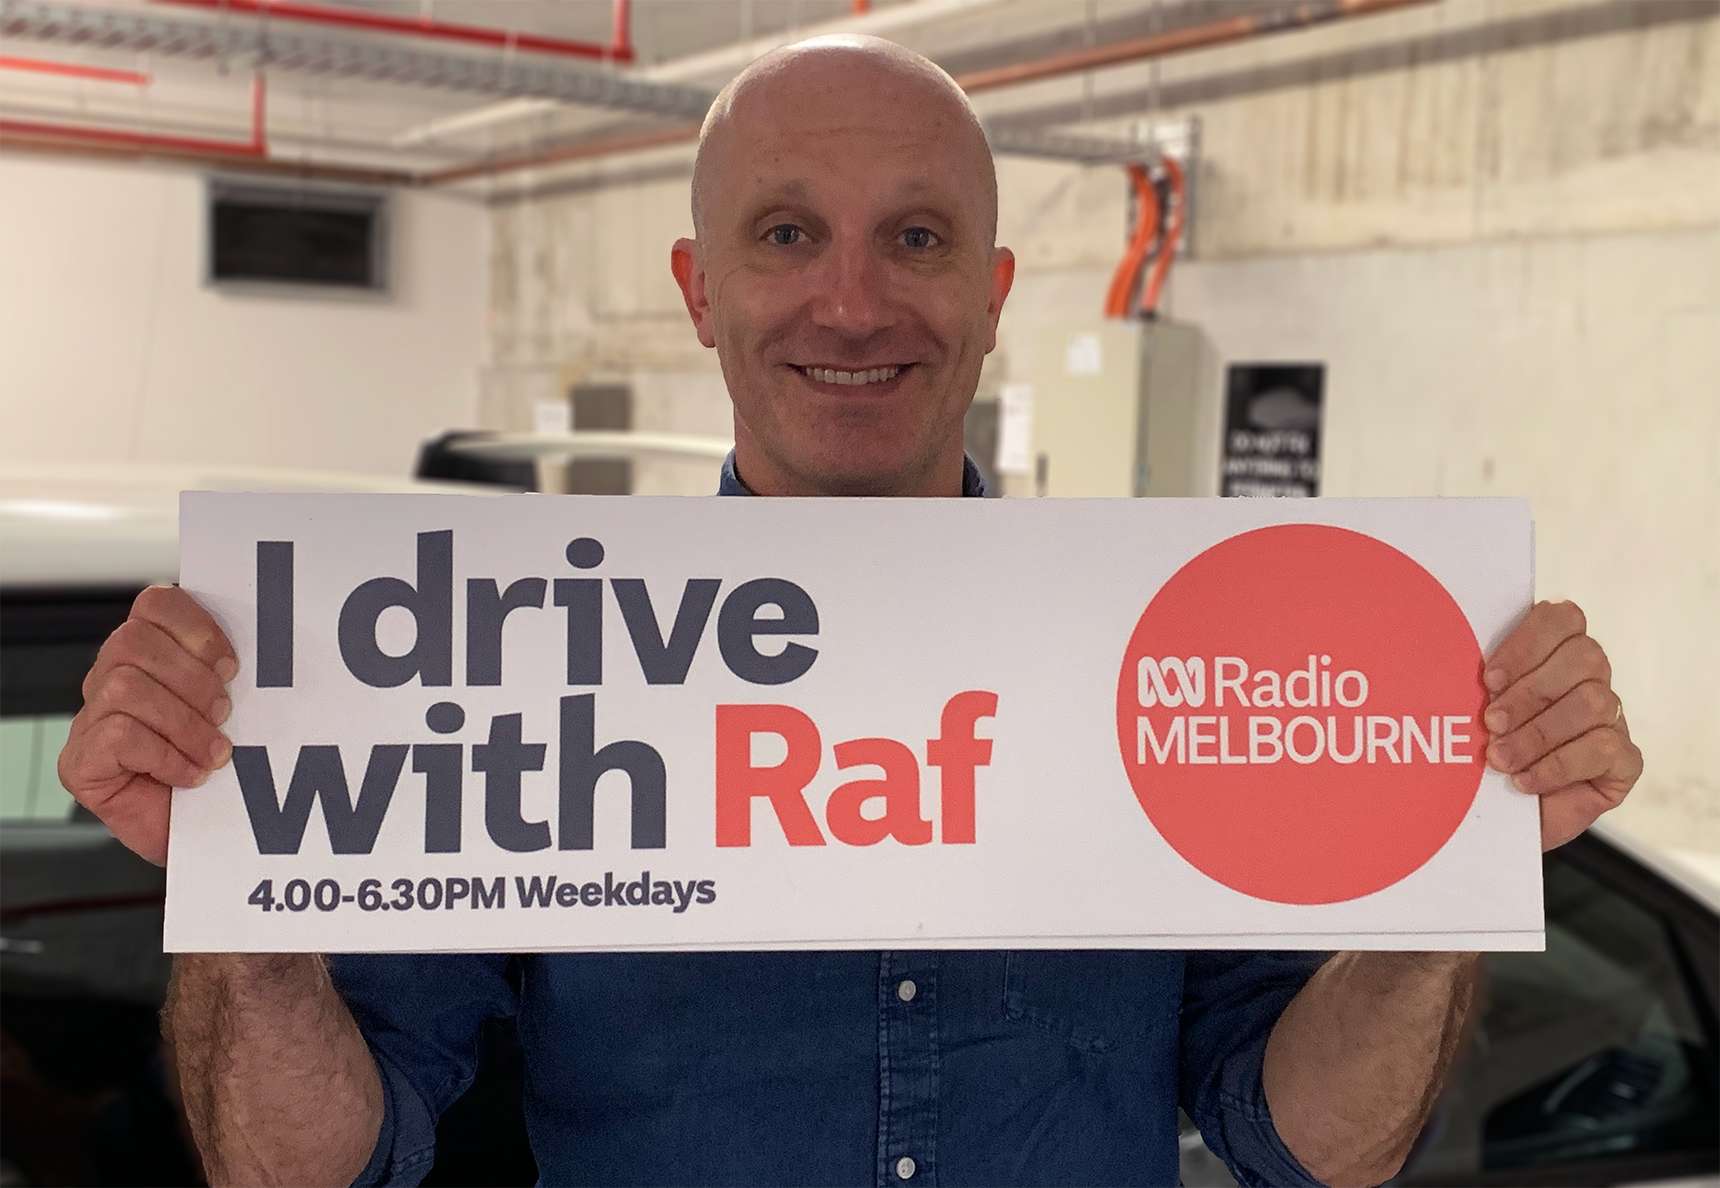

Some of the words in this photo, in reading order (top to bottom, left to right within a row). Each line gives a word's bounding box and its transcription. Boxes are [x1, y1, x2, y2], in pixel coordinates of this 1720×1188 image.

[256, 541, 294, 688] I
[337, 530, 820, 688] drive
[1214, 655, 1369, 708] Radio
[1137, 715, 1473, 765] MELBOURNE
[231, 693, 667, 854] with
[715, 690, 999, 847] Raf
[248, 874, 505, 912] 4.00-6.30PM
[516, 871, 716, 912] Weekdays
